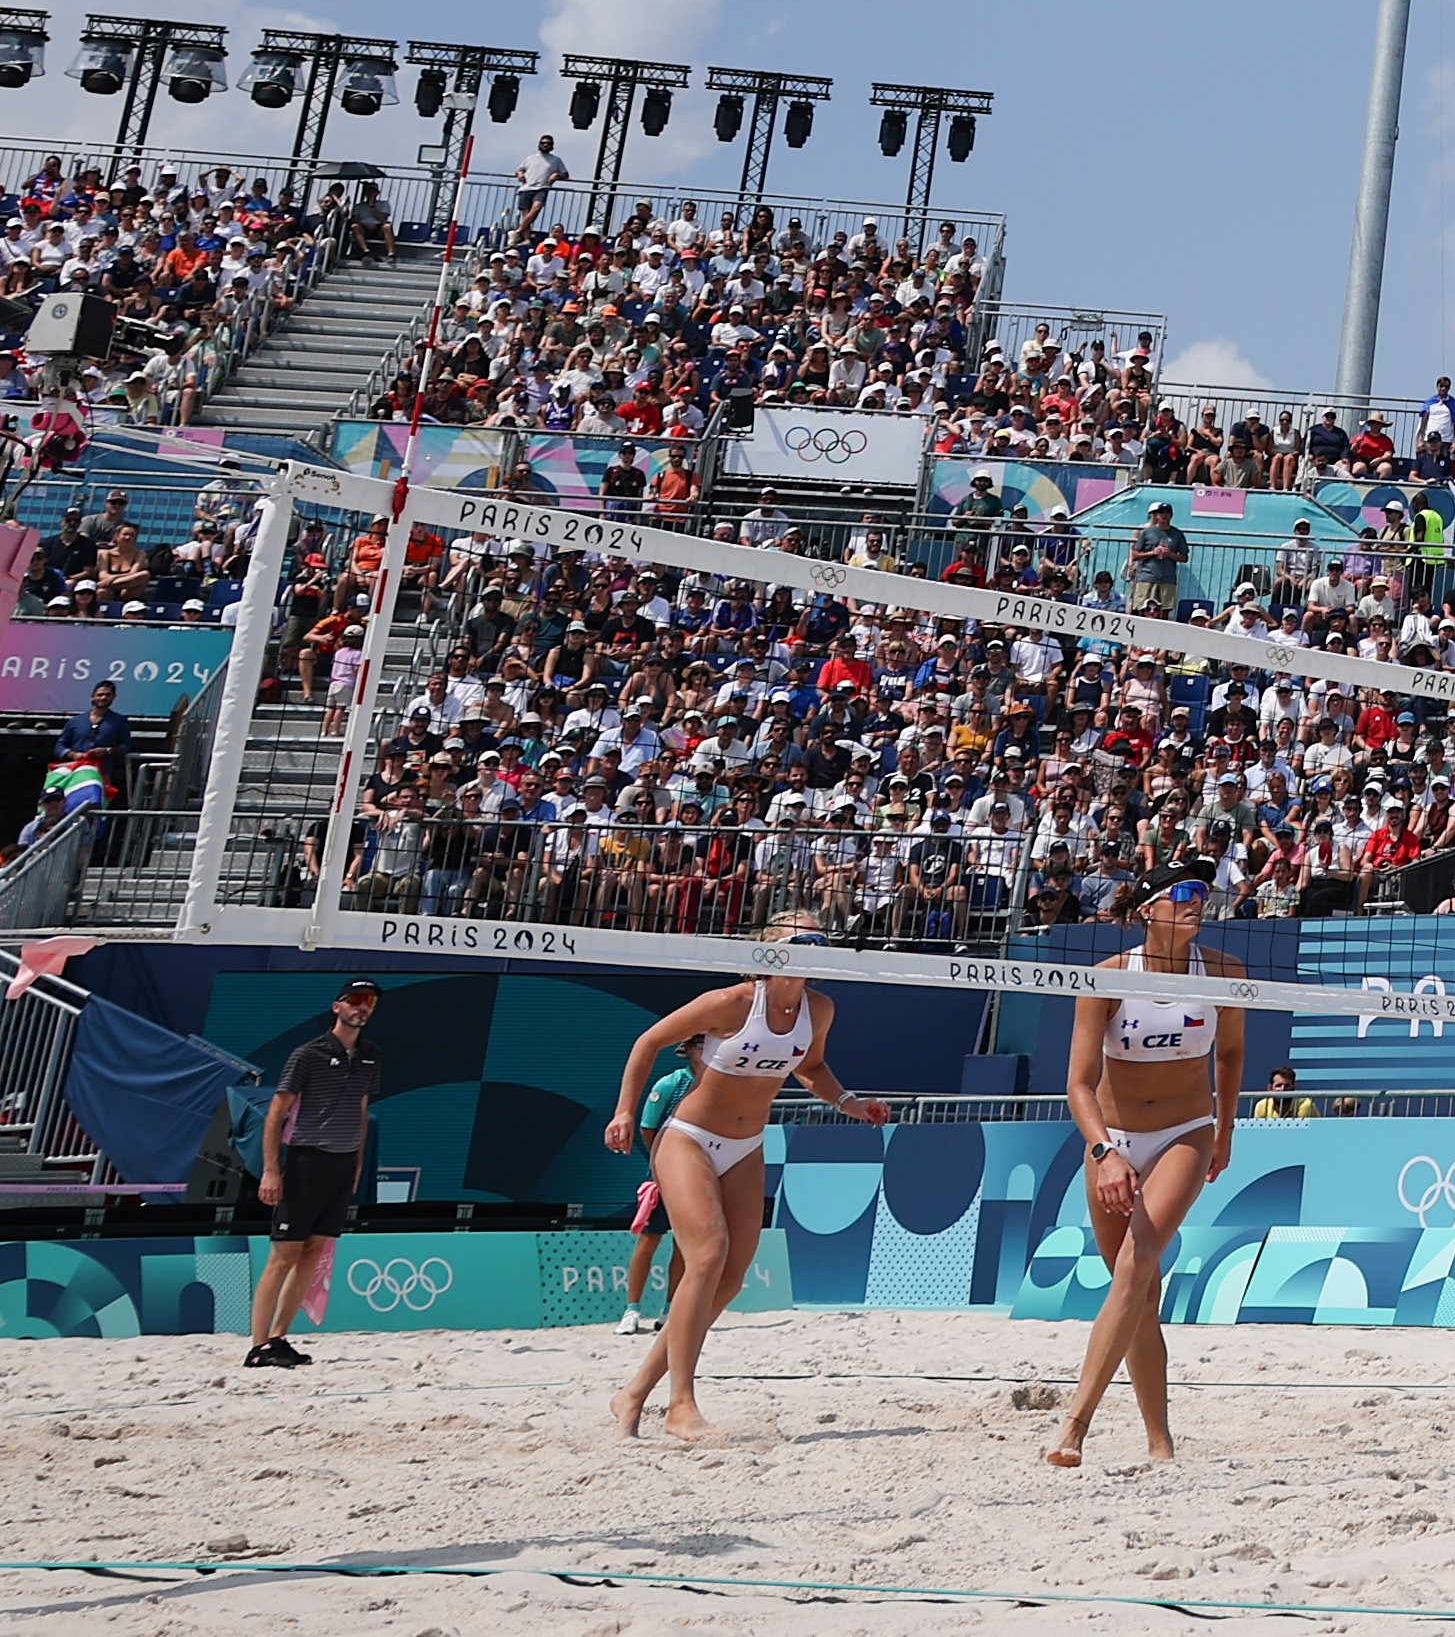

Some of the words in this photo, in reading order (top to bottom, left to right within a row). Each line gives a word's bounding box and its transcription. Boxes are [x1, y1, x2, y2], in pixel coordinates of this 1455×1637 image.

[562, 518, 643, 553] 2024
[1075, 611, 1136, 639] 2024
[107, 659, 210, 684] 2024
[493, 927, 576, 955] 2024
[1033, 968, 1096, 991] 2024
[1120, 1036, 1130, 1050] 1
[1142, 1033, 1183, 1048] CZE
[735, 1056, 750, 1069] 2
[755, 1059, 788, 1071] CZE
[562, 1265, 667, 1293] PARS
